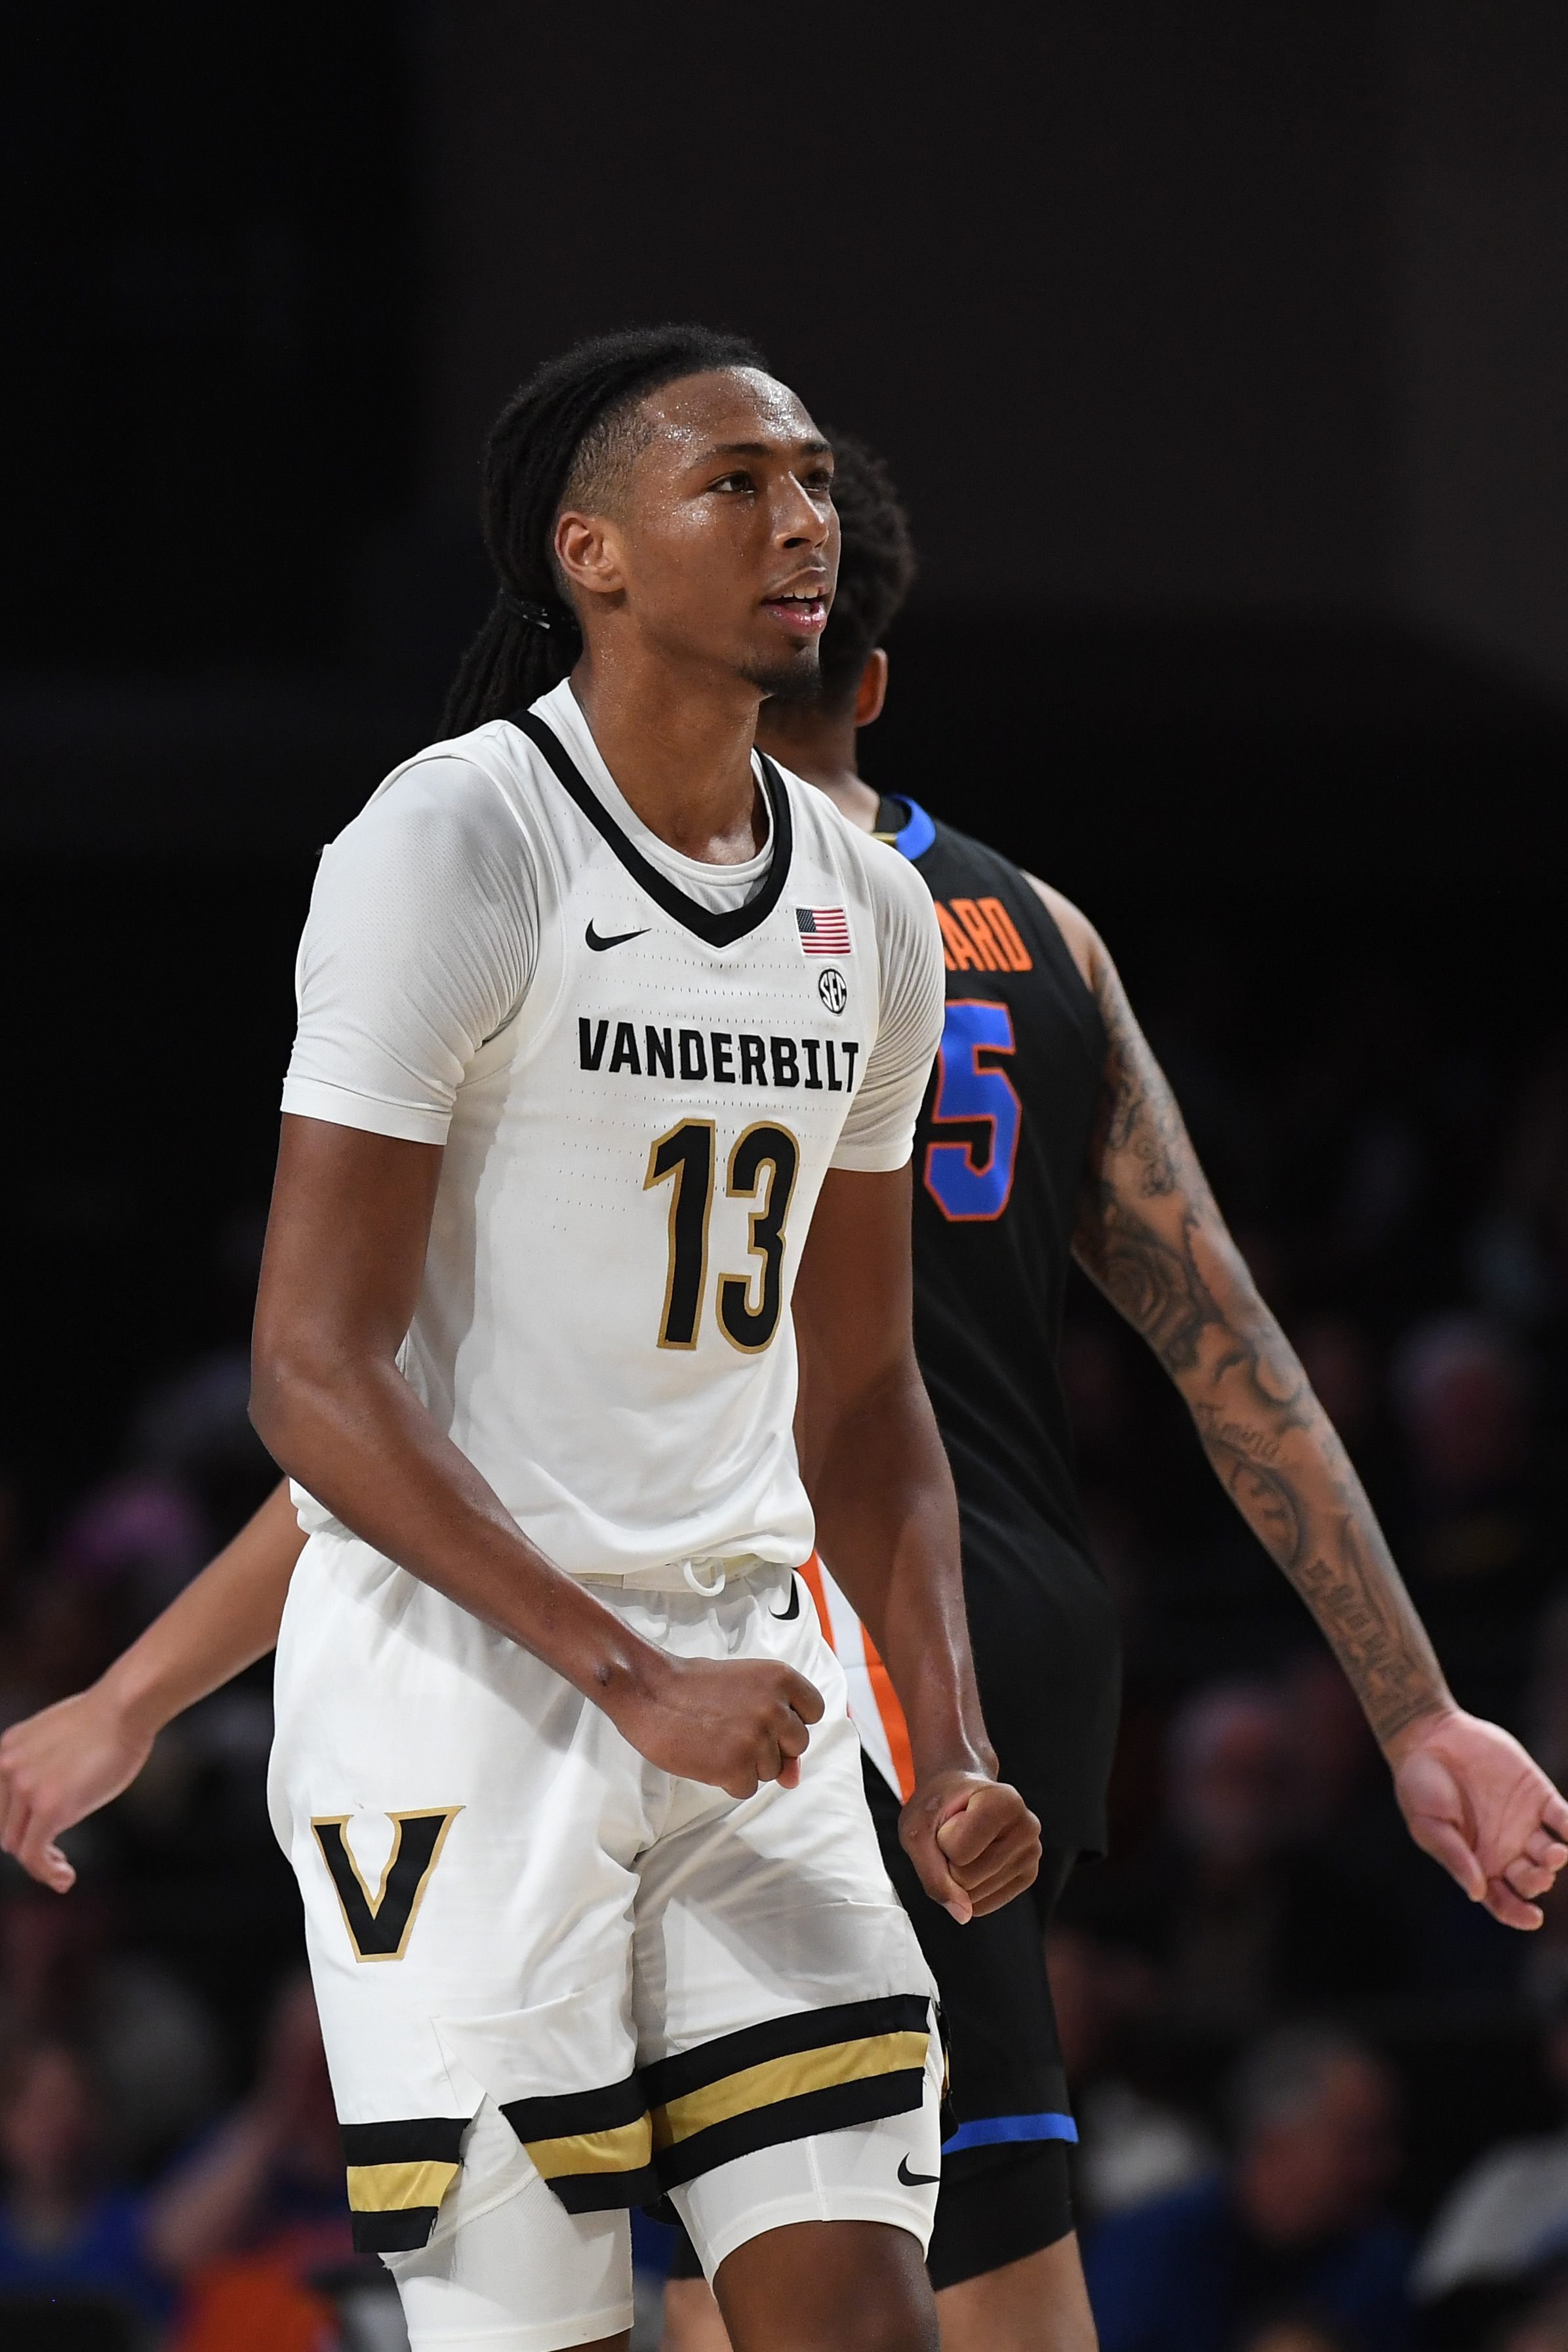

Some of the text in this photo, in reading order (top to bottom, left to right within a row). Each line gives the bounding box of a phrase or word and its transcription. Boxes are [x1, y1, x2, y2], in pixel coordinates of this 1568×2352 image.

[820, 971, 846, 1011] SEC
[935, 896, 1034, 973] ARD
[578, 1017, 859, 1093] VANDERBILT
[924, 998, 1022, 1222] 5
[643, 1117, 800, 1354] 13
[310, 1805, 467, 1963] V
